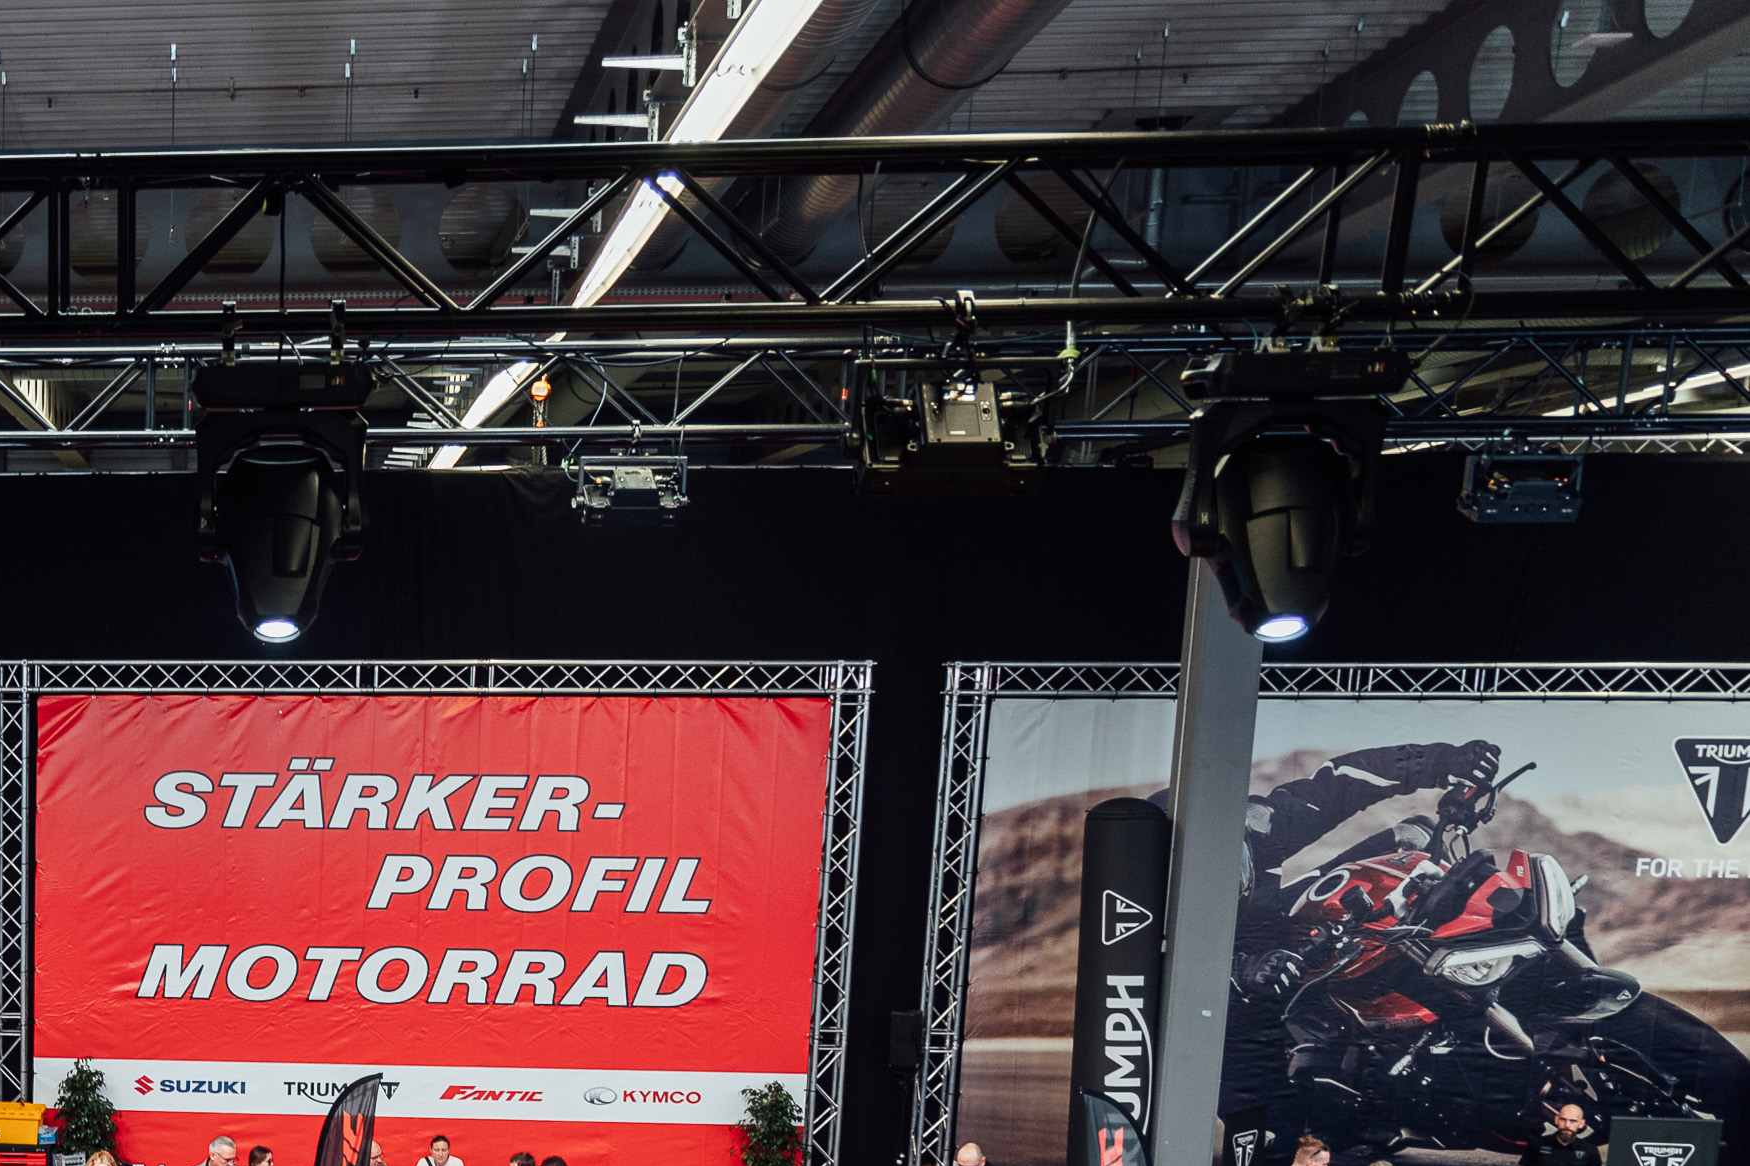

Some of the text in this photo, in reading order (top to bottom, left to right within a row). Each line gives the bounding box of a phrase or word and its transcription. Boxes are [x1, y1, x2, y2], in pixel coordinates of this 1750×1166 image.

[1694, 744, 1750, 764] TRIUM
[143, 757, 626, 832] STÄRKER-
[1635, 857, 1740, 879] FOR THE
[365, 854, 713, 914] PROFIL
[135, 943, 709, 1008] MOTORRAD
[159, 1079, 246, 1095] SUZUKI
[283, 1081, 350, 1104] TRIUM
[439, 1085, 544, 1102] FANTIC
[622, 1090, 702, 1105] KYMCO
[1643, 1146, 1683, 1157] TRIUMPH
